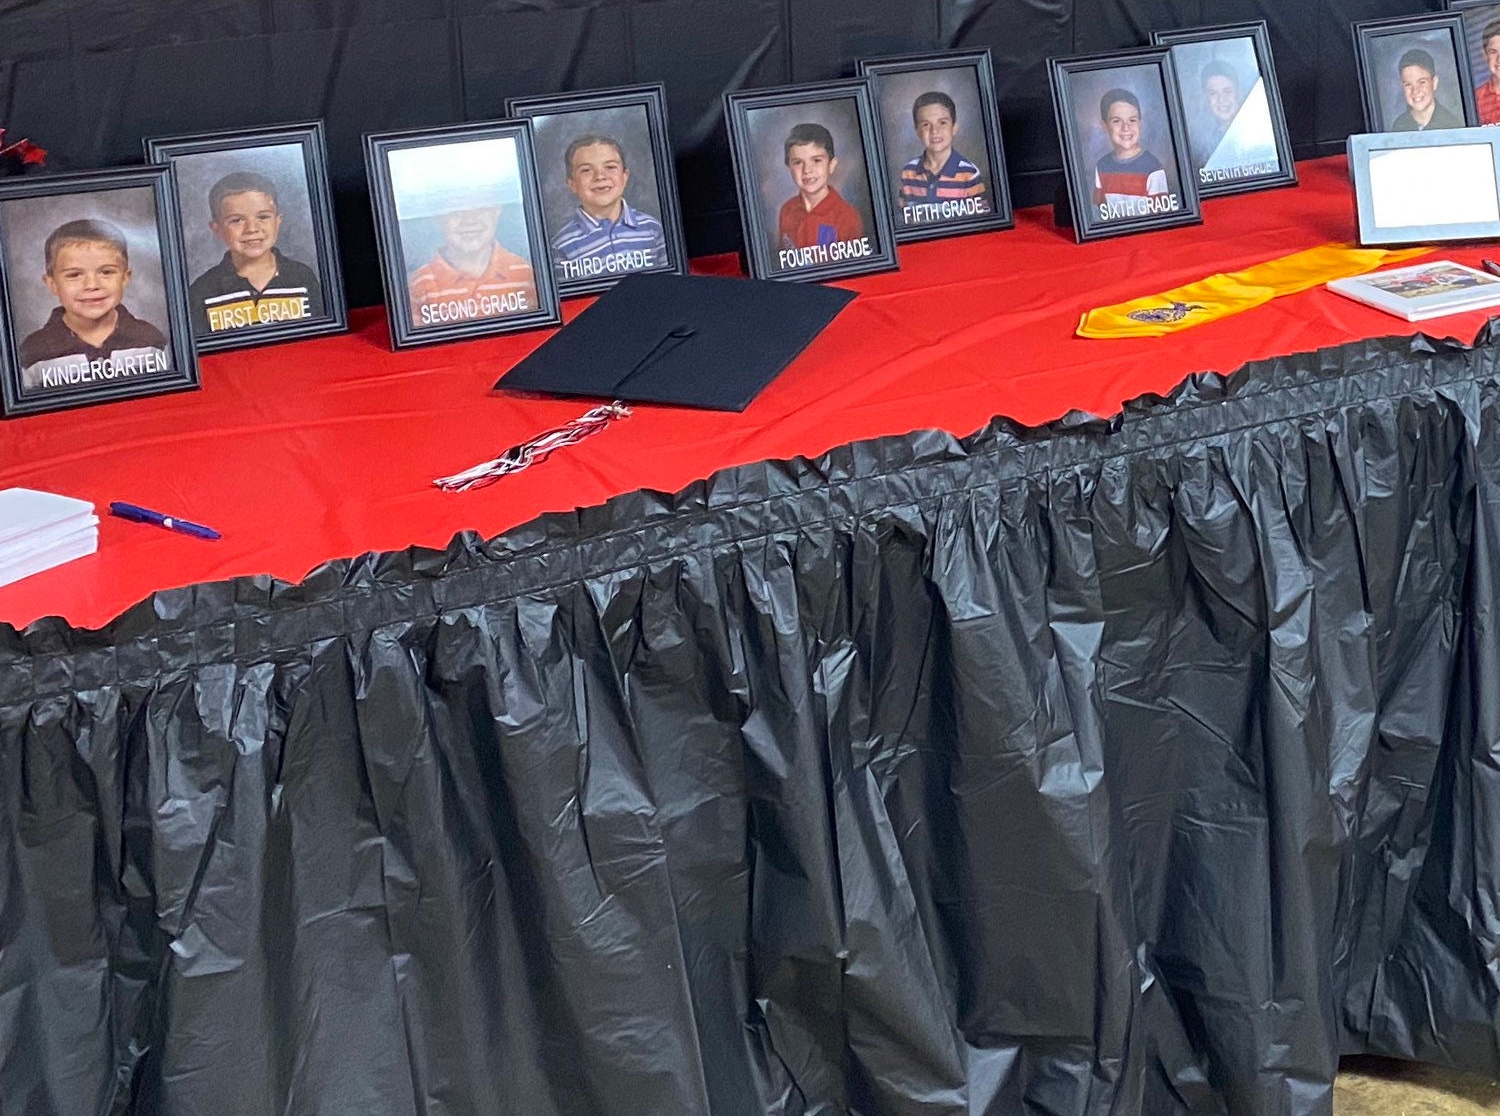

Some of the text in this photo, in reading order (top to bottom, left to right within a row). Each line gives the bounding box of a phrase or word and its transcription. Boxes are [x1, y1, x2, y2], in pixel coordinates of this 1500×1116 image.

[902, 196, 984, 224] FIFTH GRADE
[1099, 193, 1180, 221] SIXTH GRADE
[560, 249, 654, 279] THIRD GRADE
[778, 237, 872, 270] FOURTH GRADE
[208, 297, 312, 332] FIRST GRADE
[420, 290, 528, 325] SECOND GRADE
[41, 351, 169, 388] KINDERGARTEN
